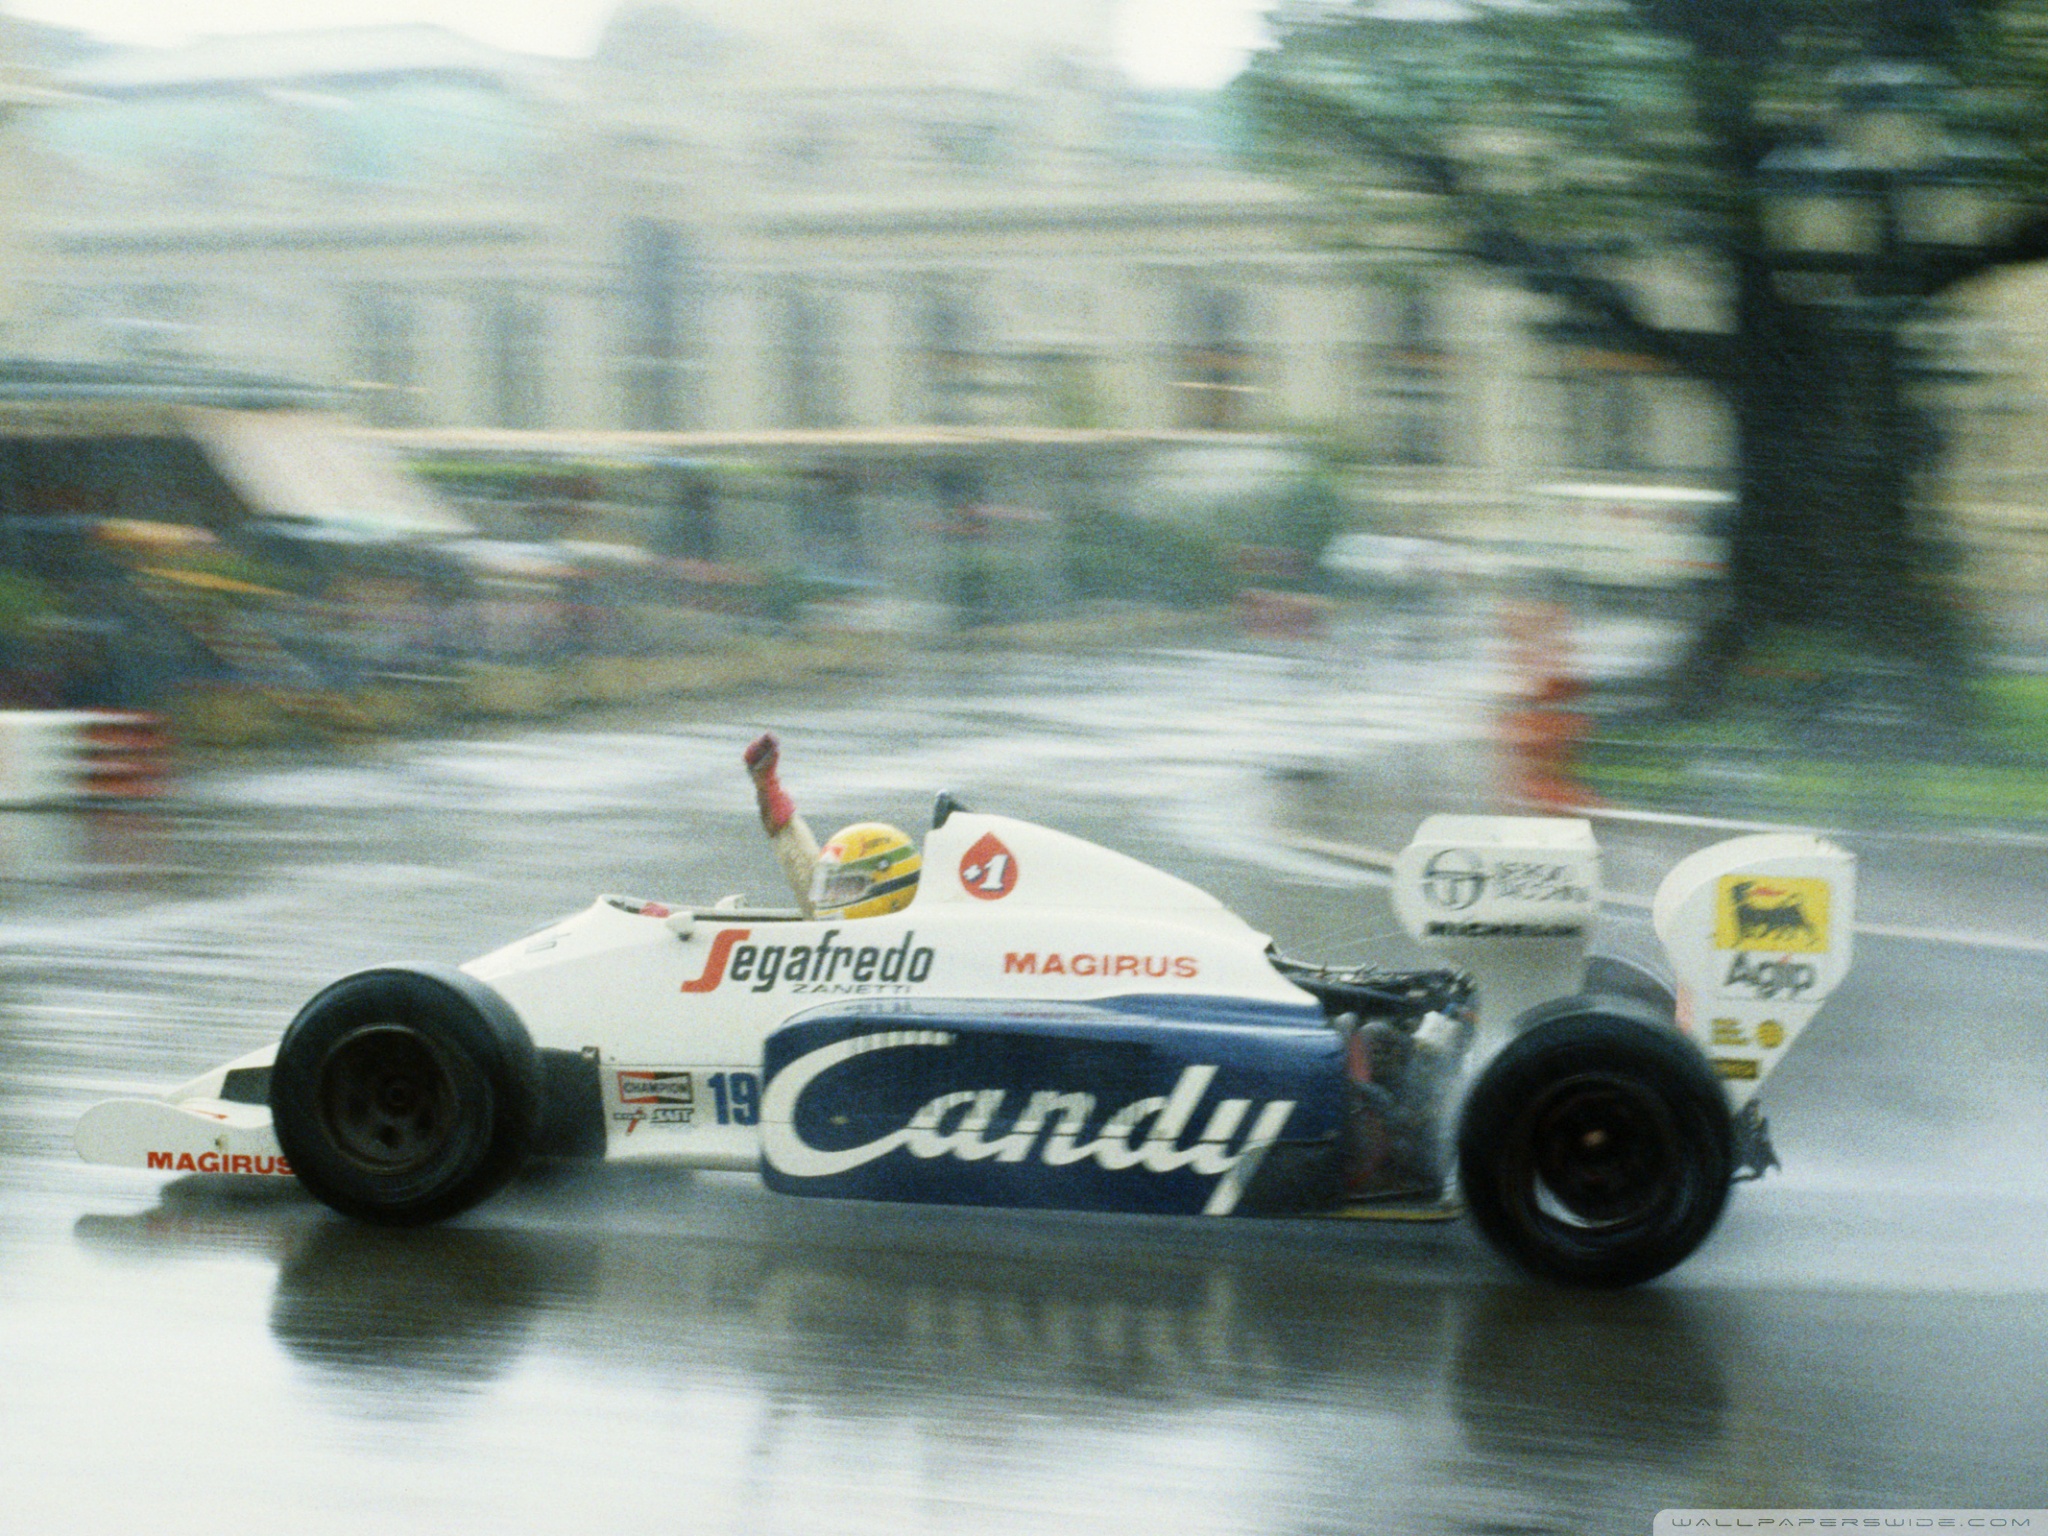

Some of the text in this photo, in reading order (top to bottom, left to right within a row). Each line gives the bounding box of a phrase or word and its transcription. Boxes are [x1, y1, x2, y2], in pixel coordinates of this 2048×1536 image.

[680, 928, 936, 994] Segafredo
[1003, 952, 1199, 979] MAGIRUS
[1723, 951, 1817, 1001] Agip
[791, 983, 912, 995] ZANETTI
[622, 1080, 689, 1095] CHAMPION
[707, 1072, 761, 1126] 19
[760, 1029, 1298, 1217] Candy
[147, 1151, 294, 1175] MAGIRUS
